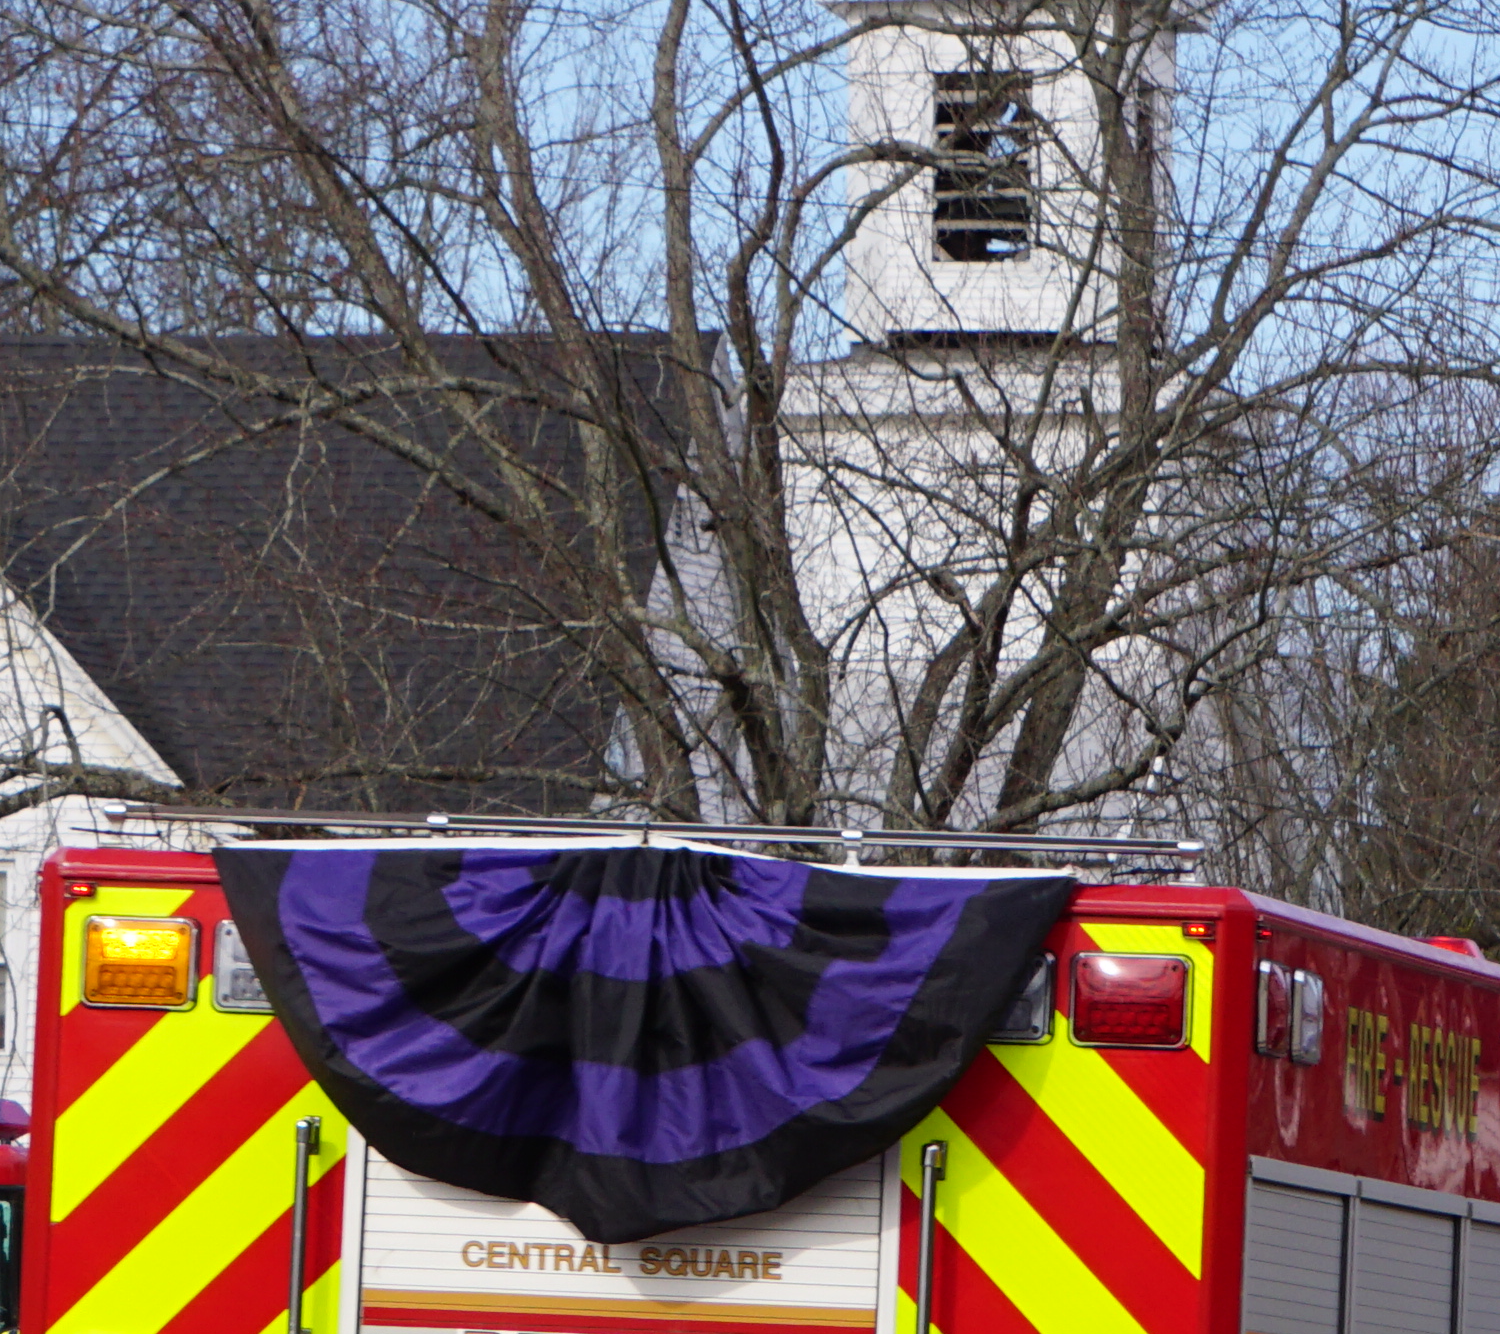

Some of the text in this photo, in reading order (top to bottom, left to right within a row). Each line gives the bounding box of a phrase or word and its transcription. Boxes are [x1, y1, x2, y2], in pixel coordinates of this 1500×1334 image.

[1343, 1005, 1389, 1123] FIRE
[1406, 1022, 1482, 1144] RESCUE
[461, 1240, 783, 1280] CENTRAL SQUARE
